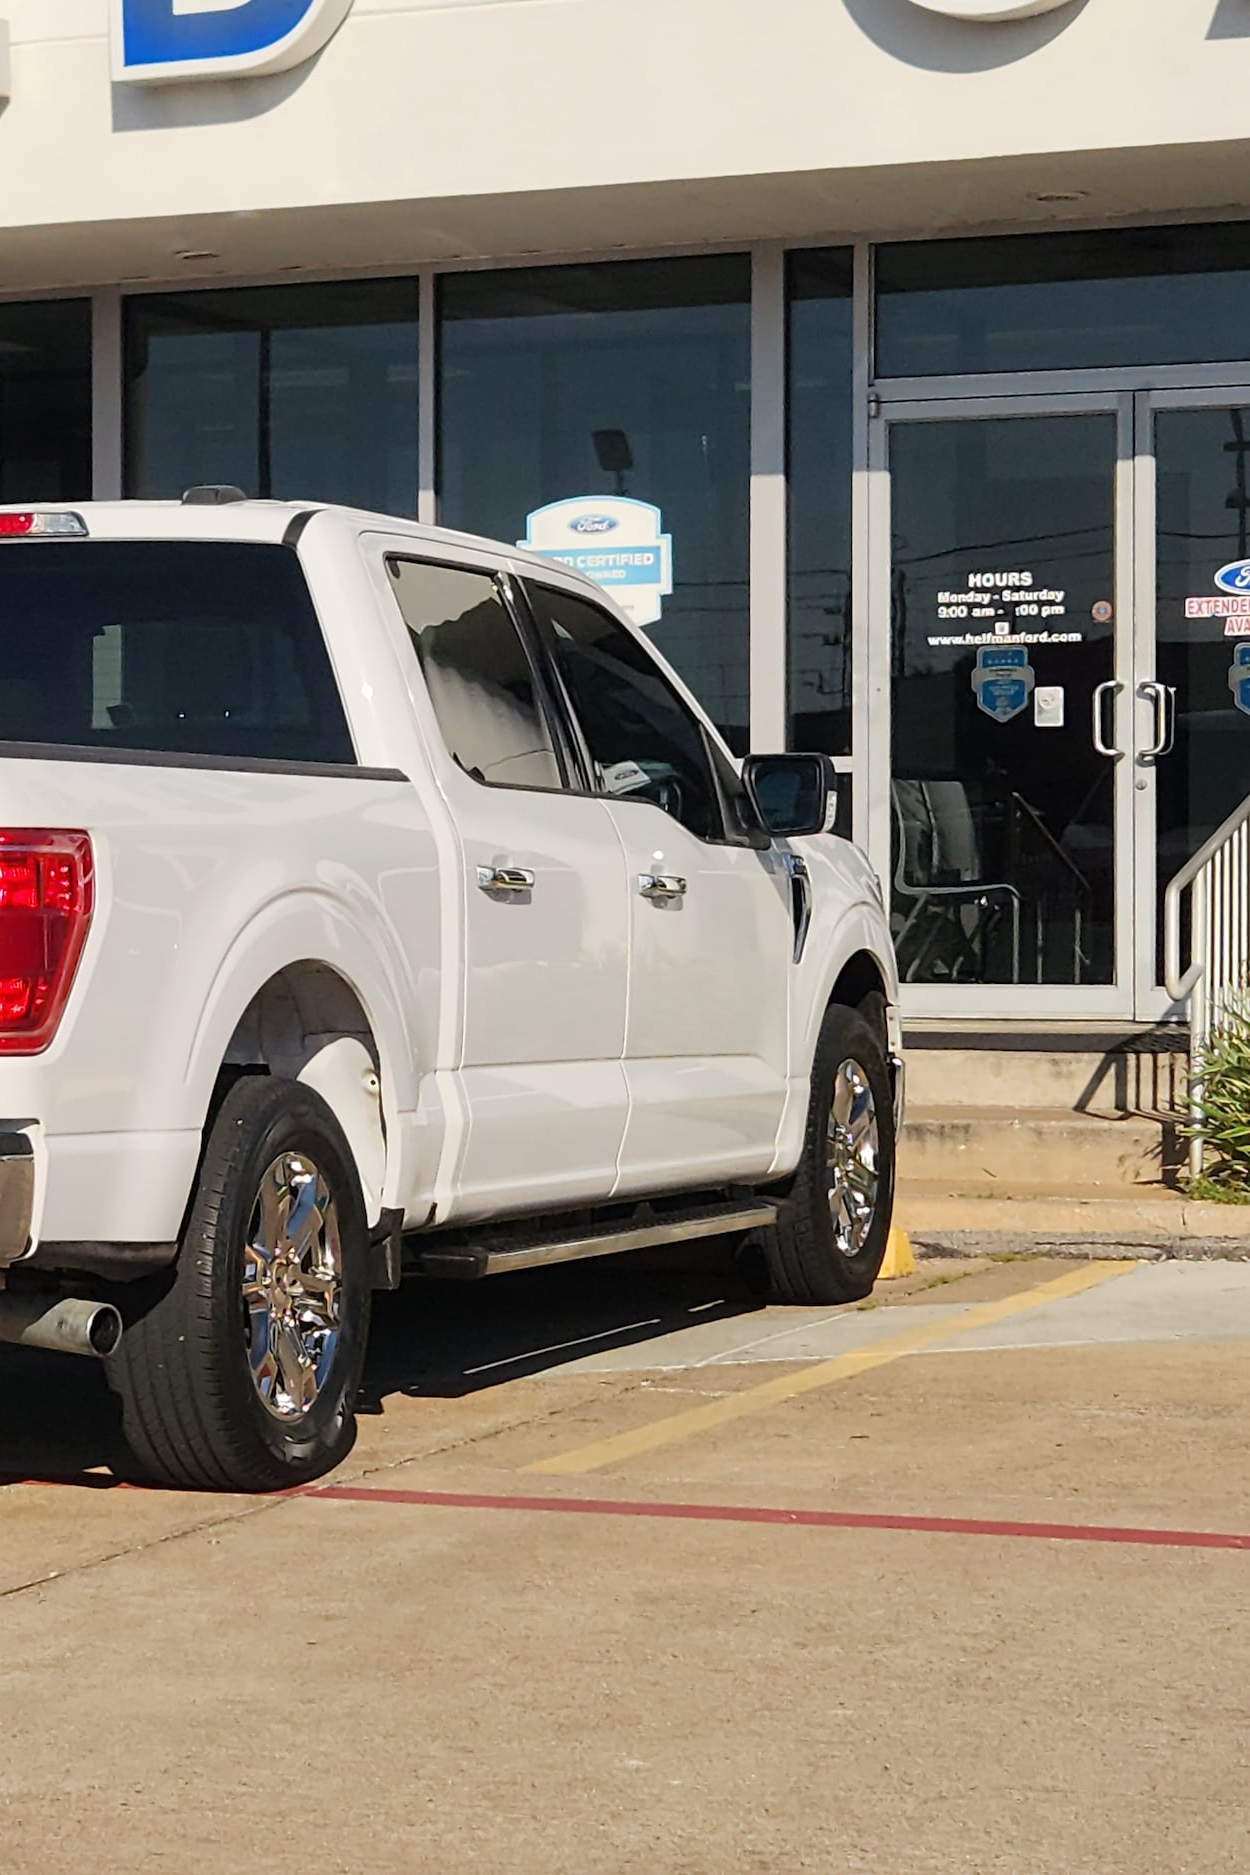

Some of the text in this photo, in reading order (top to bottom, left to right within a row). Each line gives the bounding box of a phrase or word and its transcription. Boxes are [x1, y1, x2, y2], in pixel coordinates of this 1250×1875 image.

[576, 553, 654, 567] CERTIFIED
[968, 572, 1033, 587] HOURS
[937, 591, 991, 604] Monday
[1002, 589, 1065, 602] Saturday
[937, 606, 968, 618] 9:00
[971, 607, 995, 617] am
[1041, 605, 1065, 617] pm
[1187, 598, 1250, 615] EXTENDE
